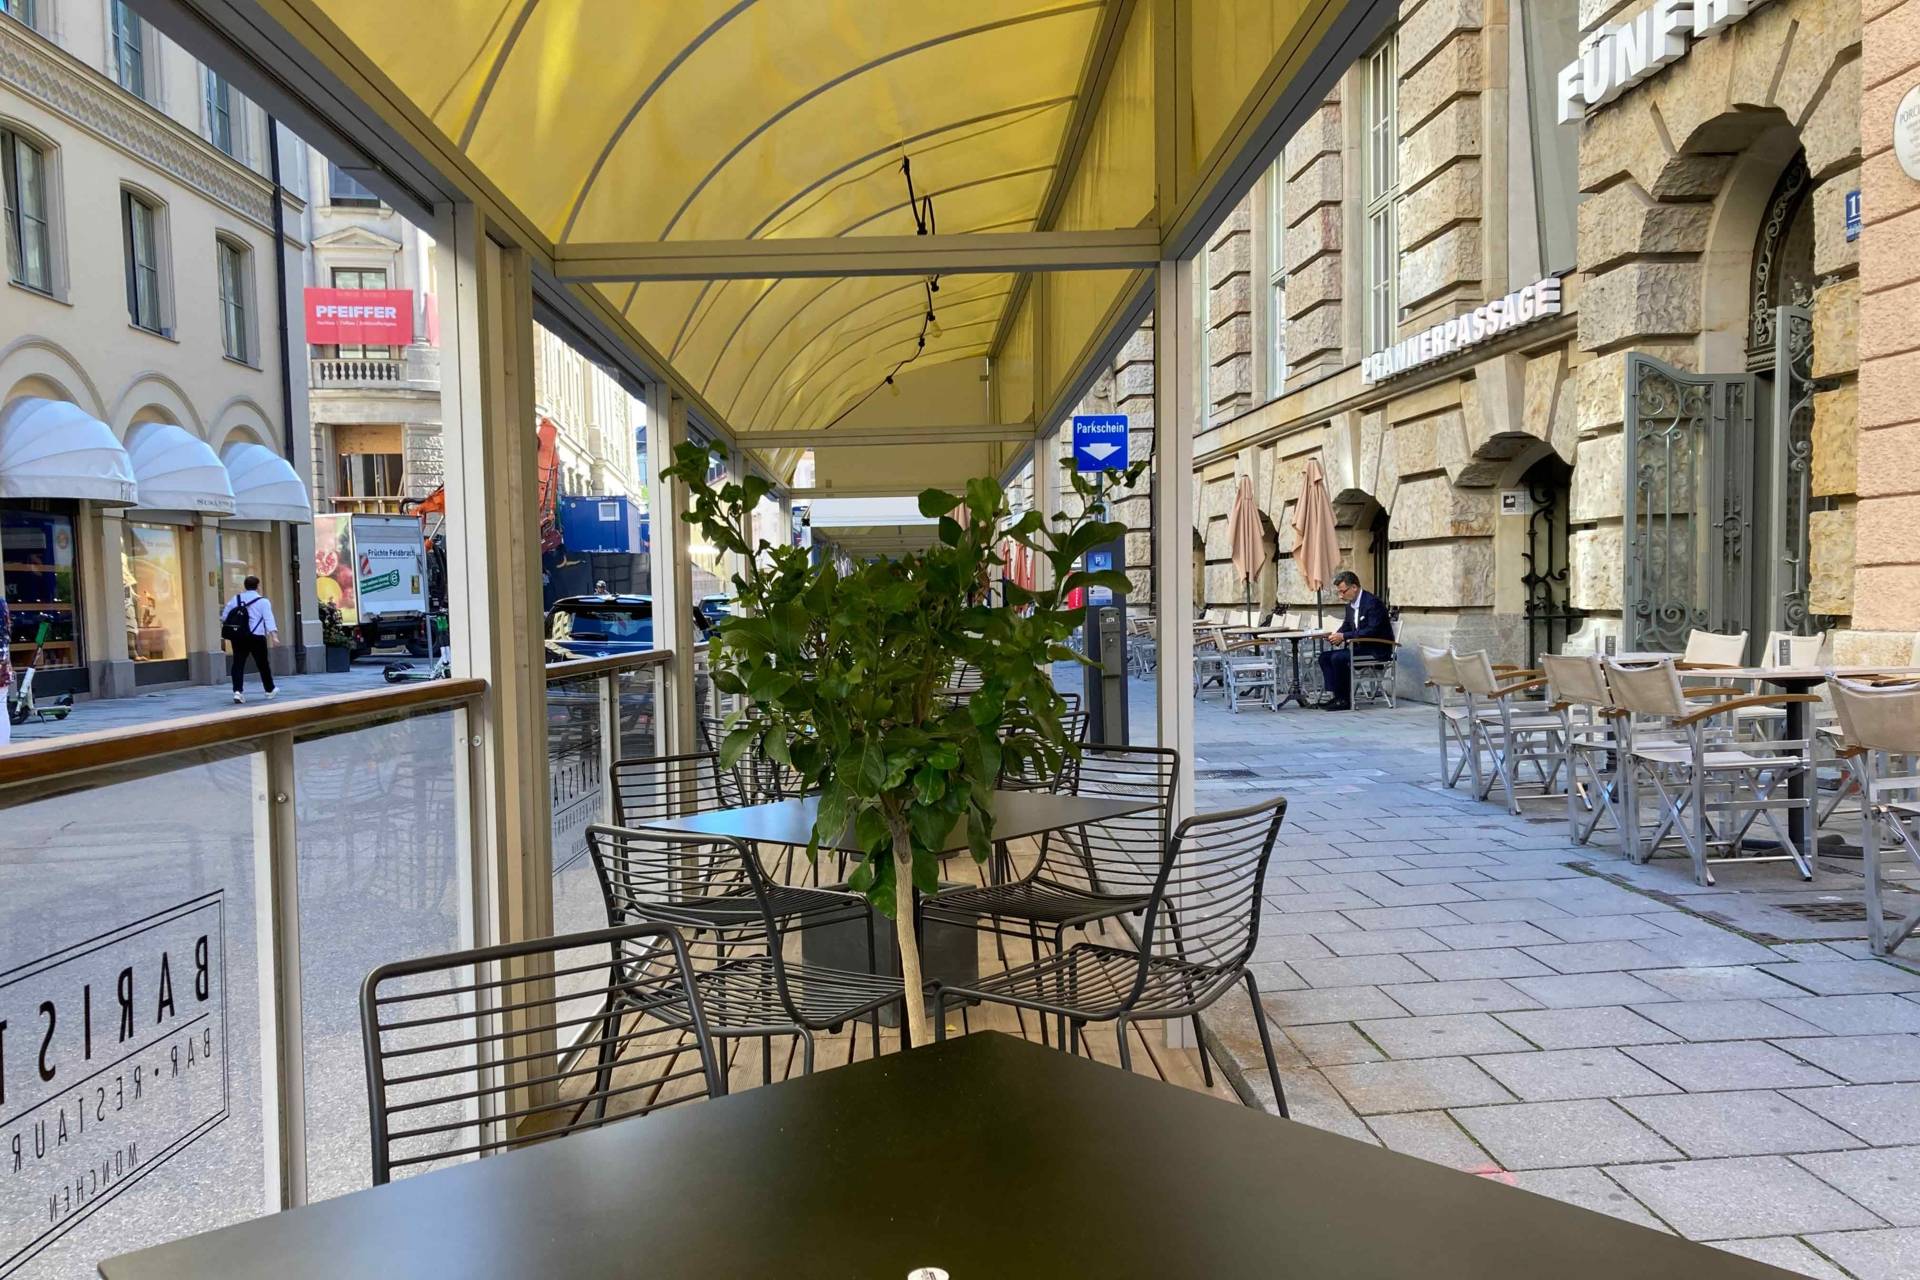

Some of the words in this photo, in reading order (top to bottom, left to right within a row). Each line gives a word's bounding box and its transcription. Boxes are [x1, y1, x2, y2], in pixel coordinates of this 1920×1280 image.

[316, 305, 397, 319] PFEIFFER
[1362, 278, 1560, 384] PRANNERPASSAGE
[1077, 421, 1125, 433] Parkschein
